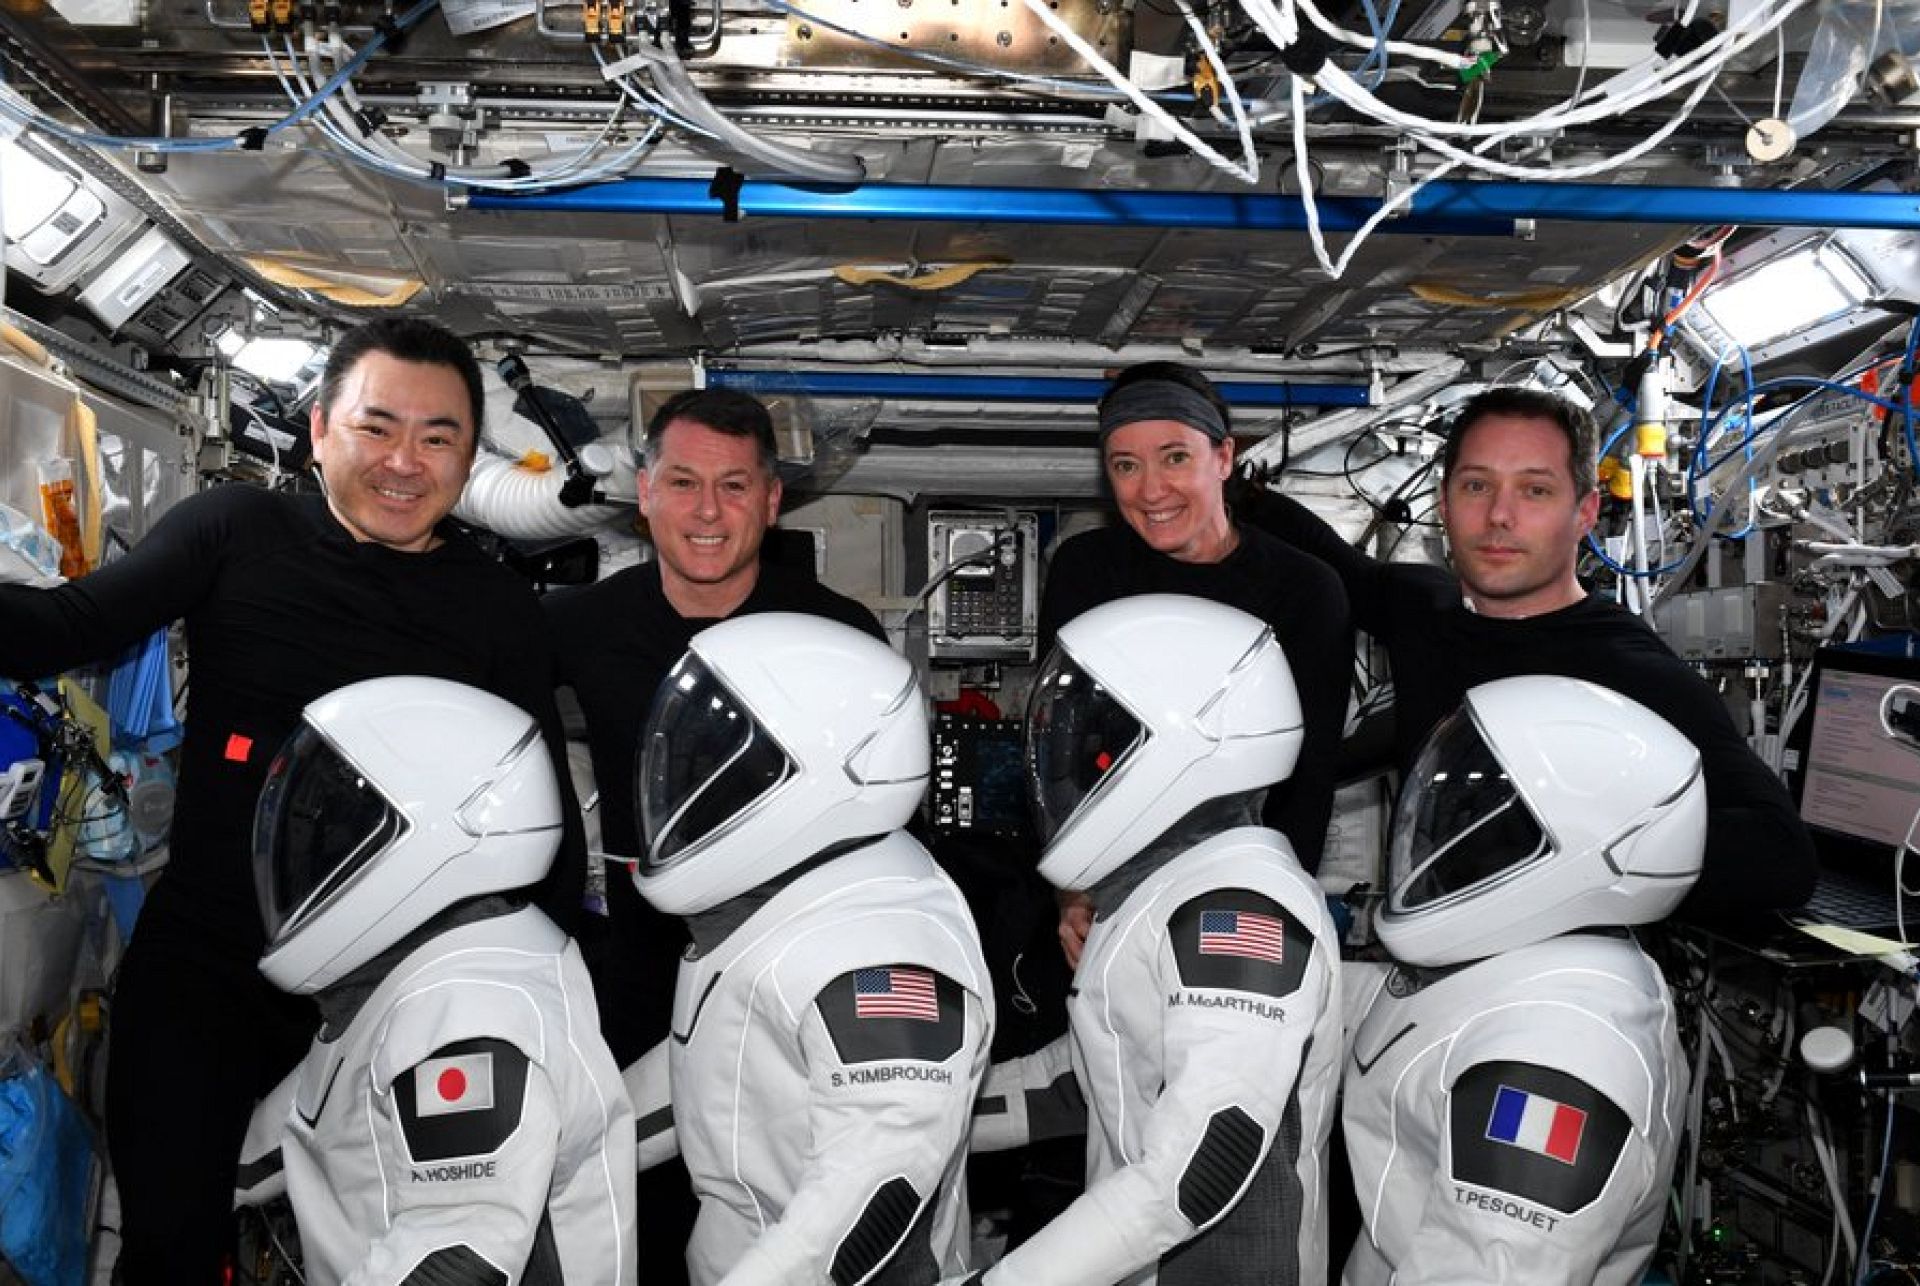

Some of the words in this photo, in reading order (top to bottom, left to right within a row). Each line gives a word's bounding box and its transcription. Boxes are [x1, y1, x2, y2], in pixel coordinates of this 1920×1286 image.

[1168, 991, 1184, 1007] M.
[1187, 993, 1285, 1023] McARTHUR
[831, 1071, 847, 1087] S.
[848, 1066, 952, 1085] KIMBROUGH
